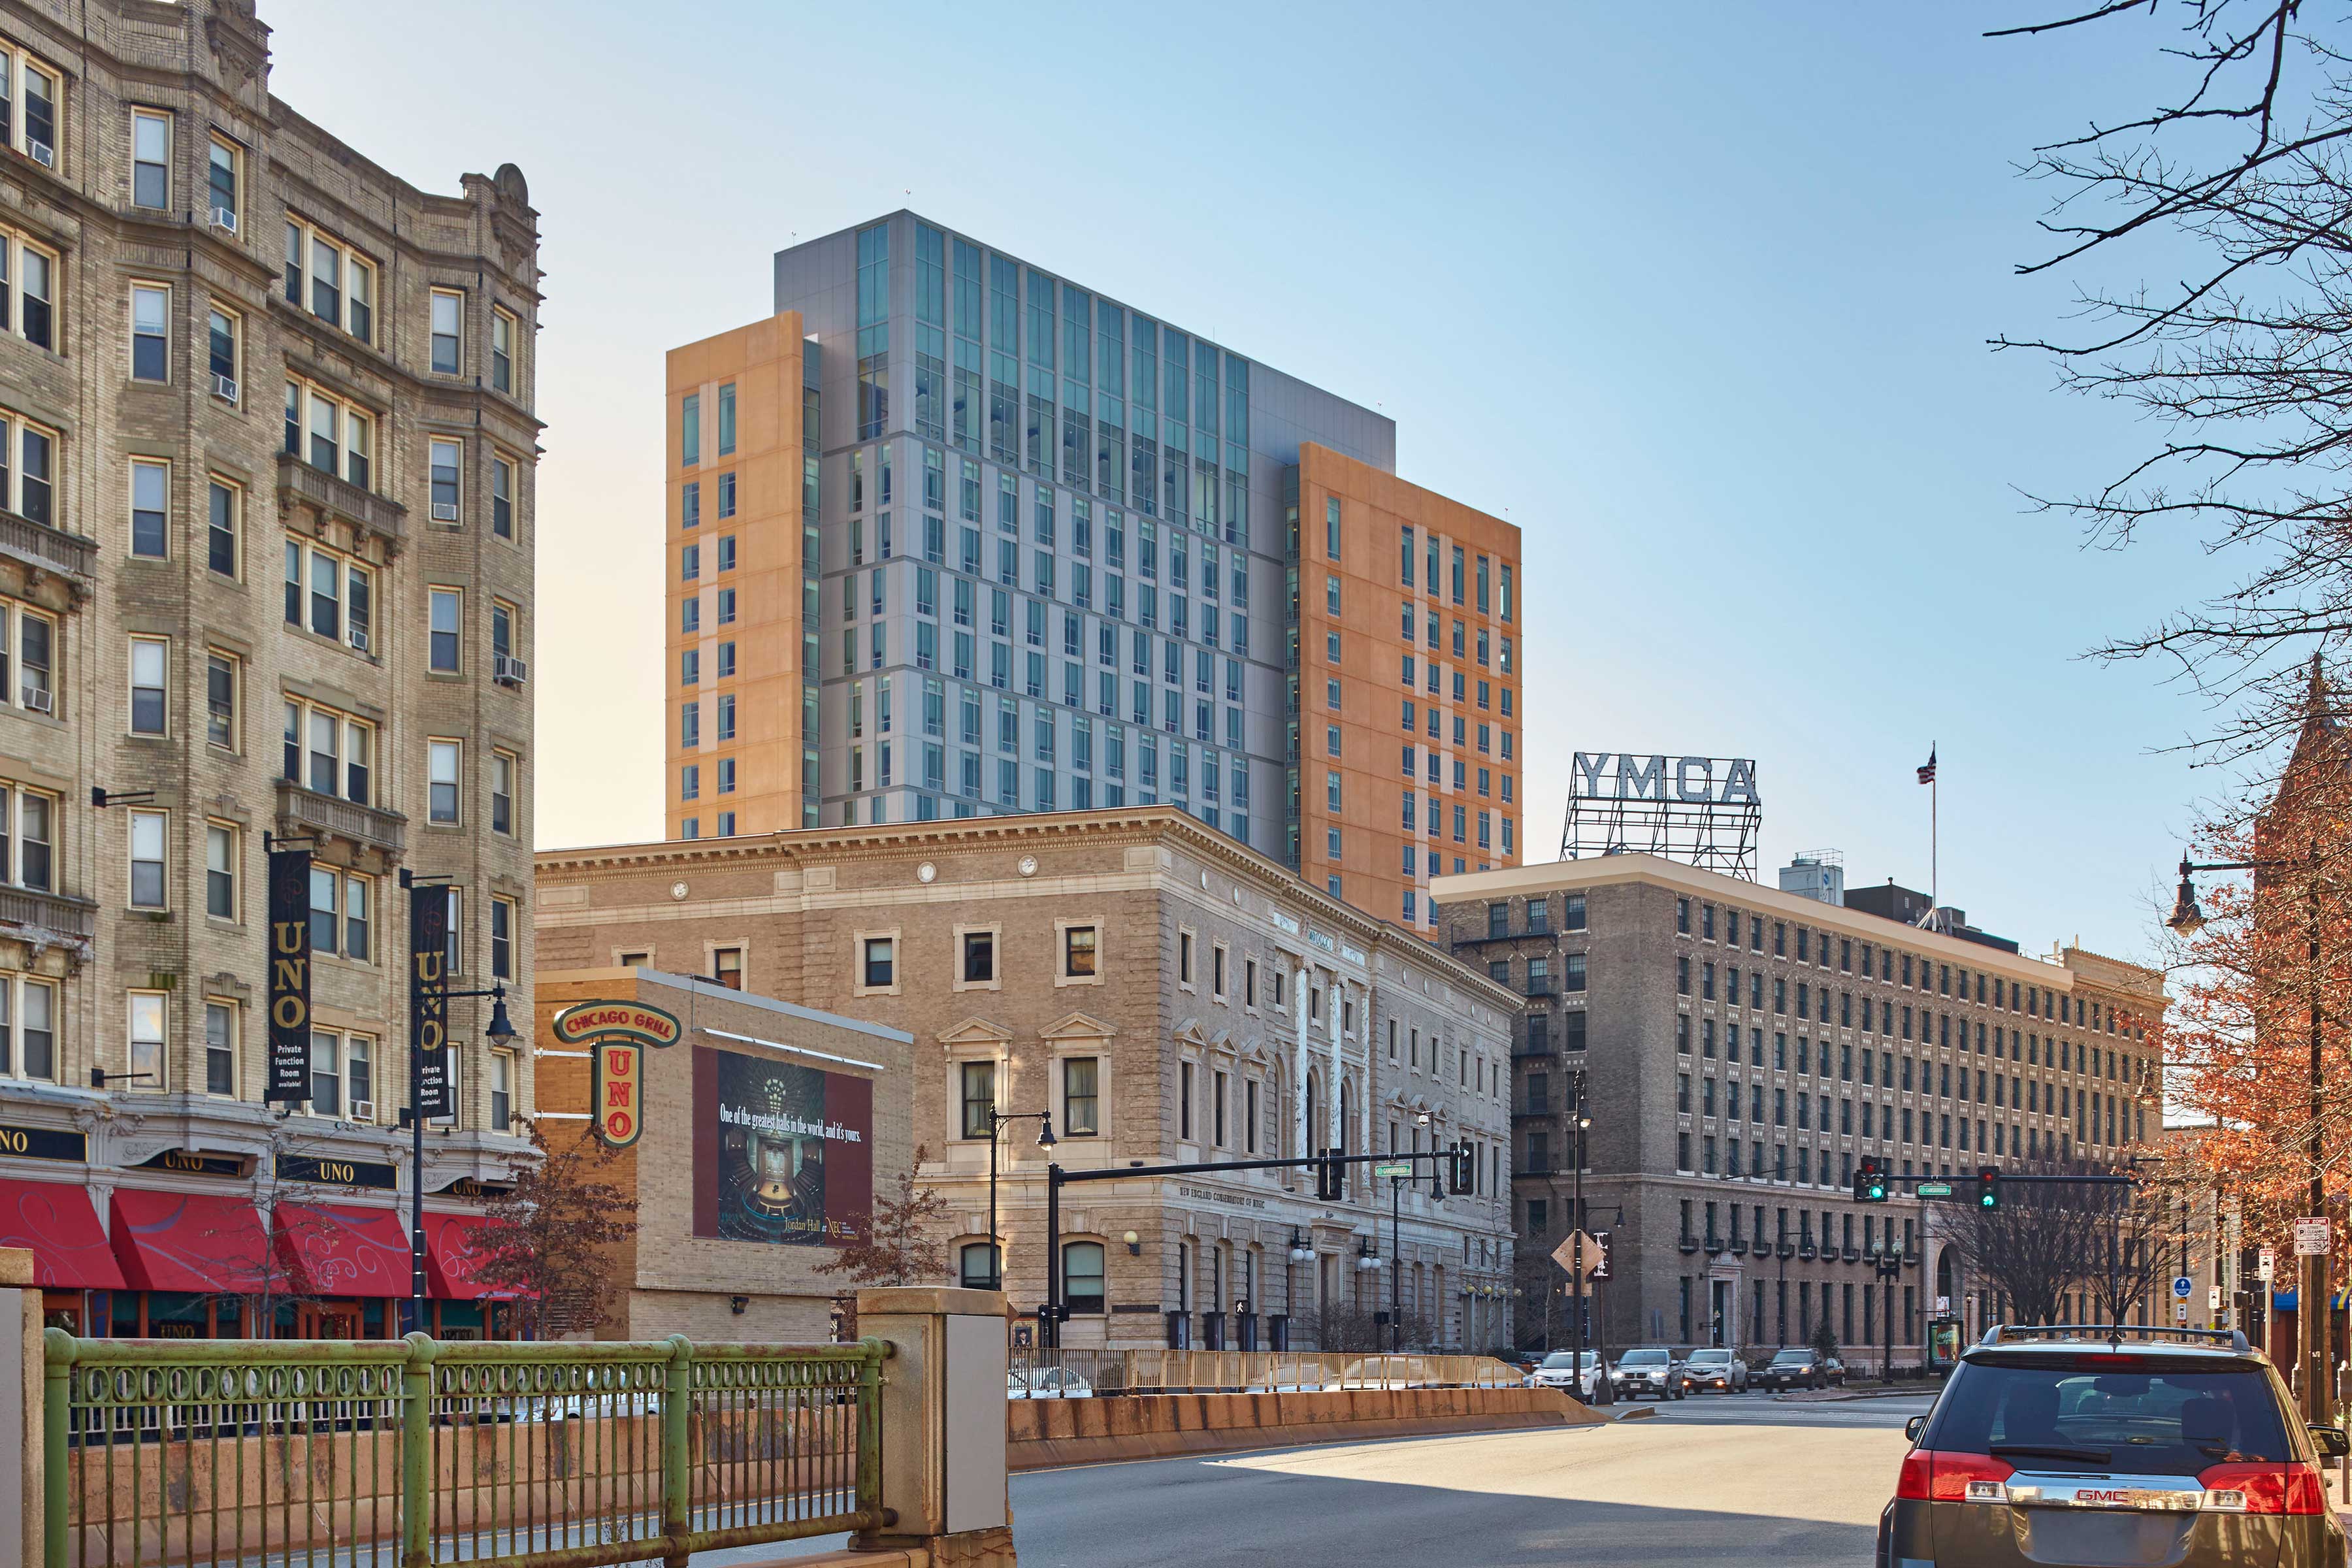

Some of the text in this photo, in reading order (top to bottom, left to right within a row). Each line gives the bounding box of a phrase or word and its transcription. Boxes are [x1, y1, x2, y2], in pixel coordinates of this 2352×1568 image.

[1575, 751, 1759, 804] YMCA
[273, 921, 306, 1028] UNO
[566, 1011, 673, 1038] CHICAGO GRILL
[277, 1045, 302, 1053] Private
[275, 1056, 304, 1066] Function
[280, 1068, 300, 1077] Room
[421, 1066, 440, 1074] rivate
[421, 1076, 443, 1085] nction
[421, 1088, 438, 1096] Room
[608, 1050, 632, 1137] UNO
[720, 1103, 861, 1143] One of the greatest halls in the world, and it's yours.
[320, 1162, 354, 1183] UNO
[1180, 1186, 1190, 1196] NEW
[1191, 1189, 1212, 1200] ENGLAND
[784, 1217, 806, 1233] Jordan
[807, 1219, 821, 1232] Hall
[825, 1217, 841, 1238] NEC
[2076, 1490, 2129, 1501] GMC
